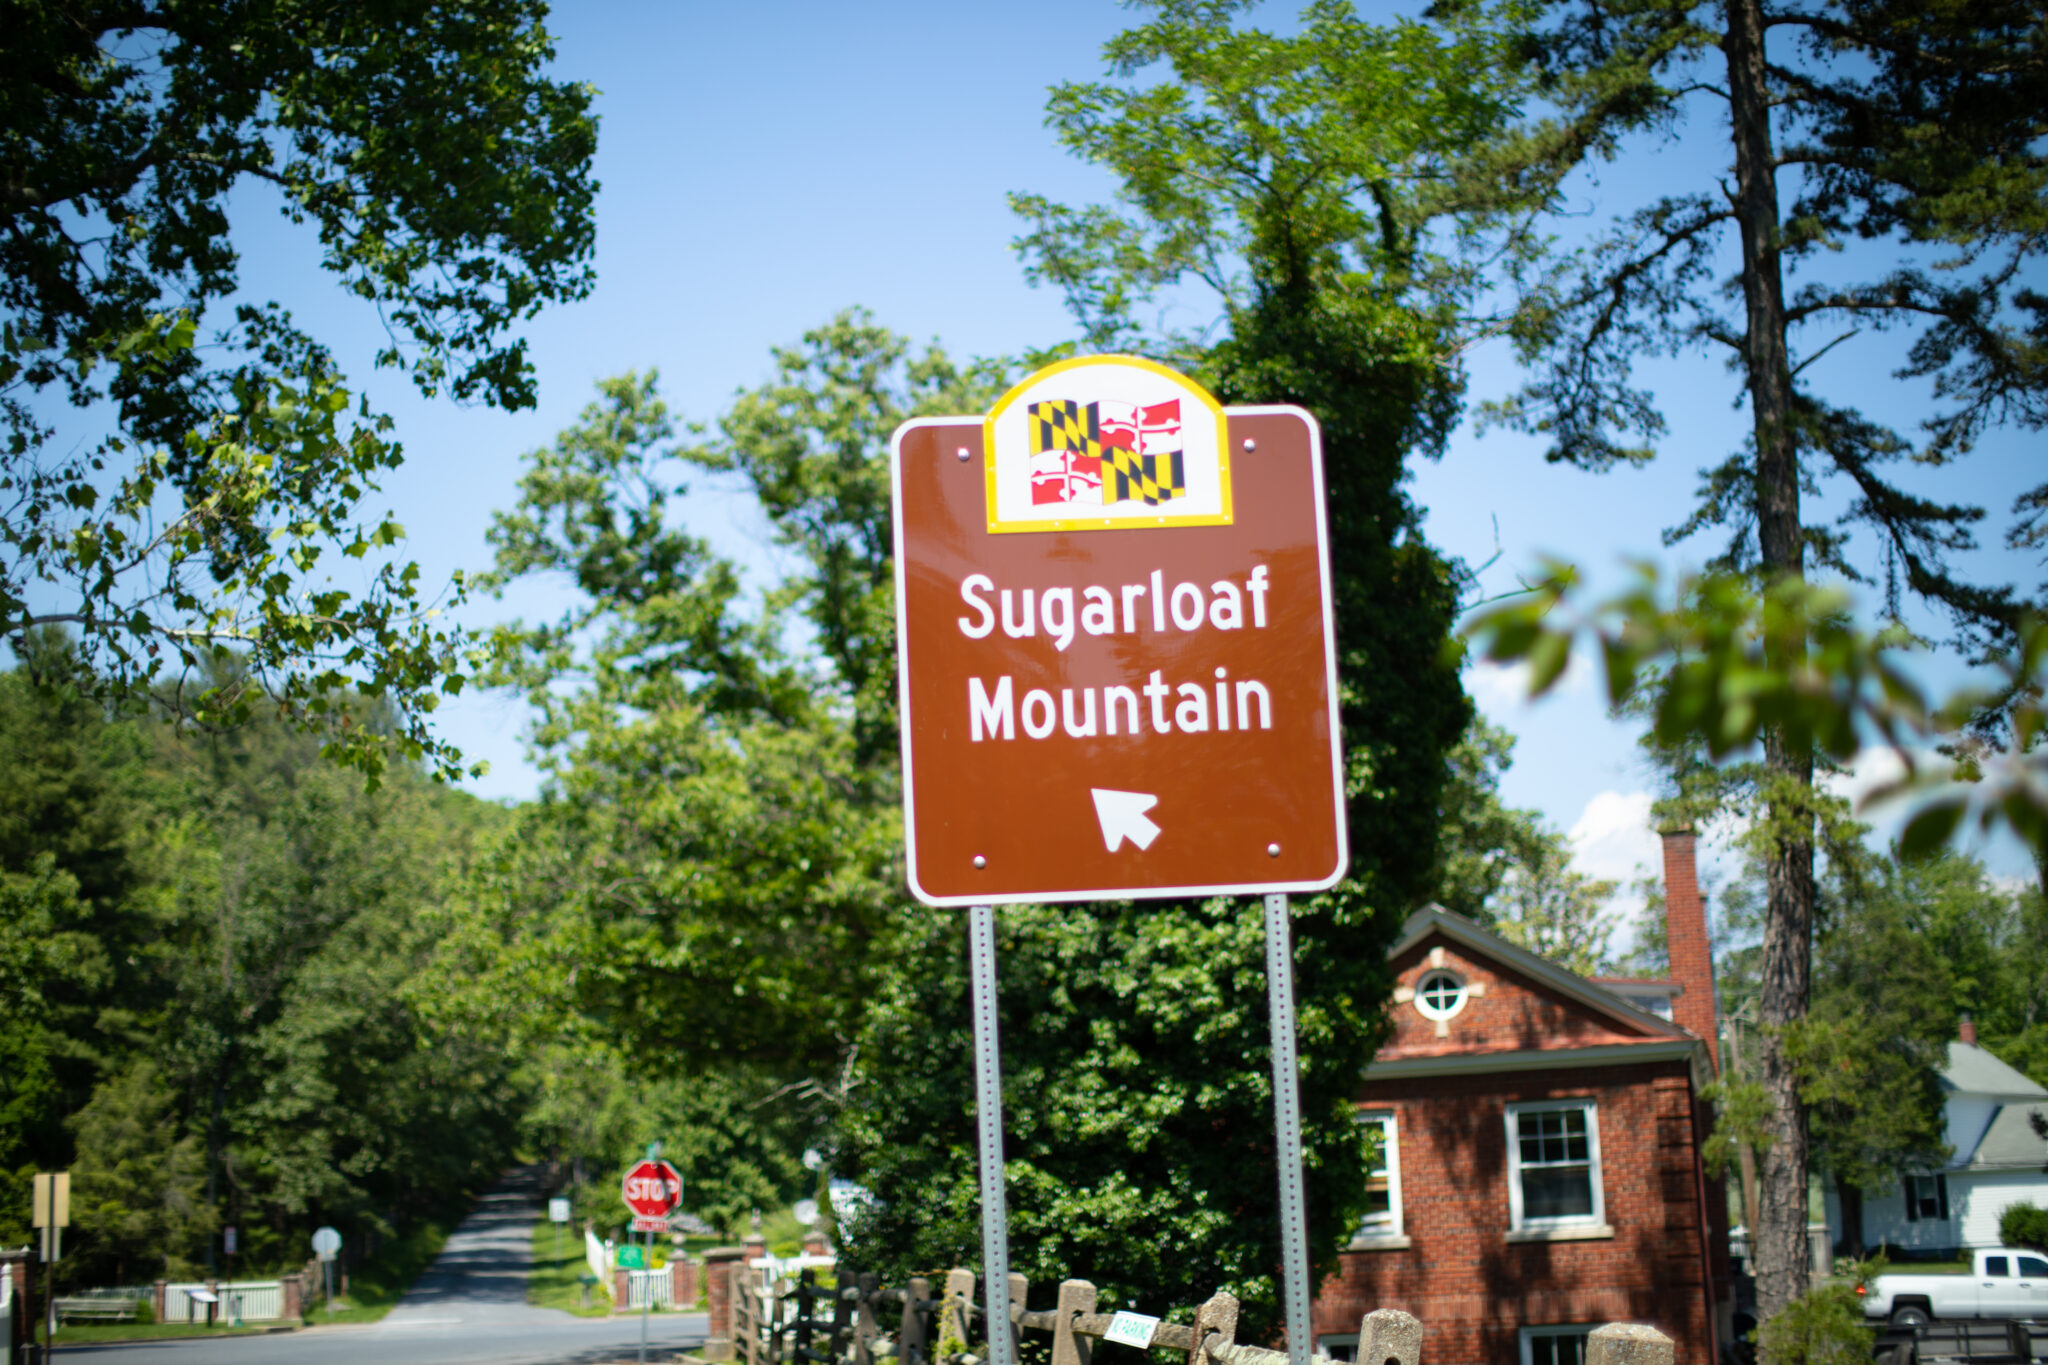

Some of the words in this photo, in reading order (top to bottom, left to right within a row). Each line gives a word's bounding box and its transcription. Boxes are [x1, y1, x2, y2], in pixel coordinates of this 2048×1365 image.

[958, 565, 1269, 652] Sugarloaf
[968, 667, 1272, 742] Mountain
[627, 1177, 679, 1201] STOP
